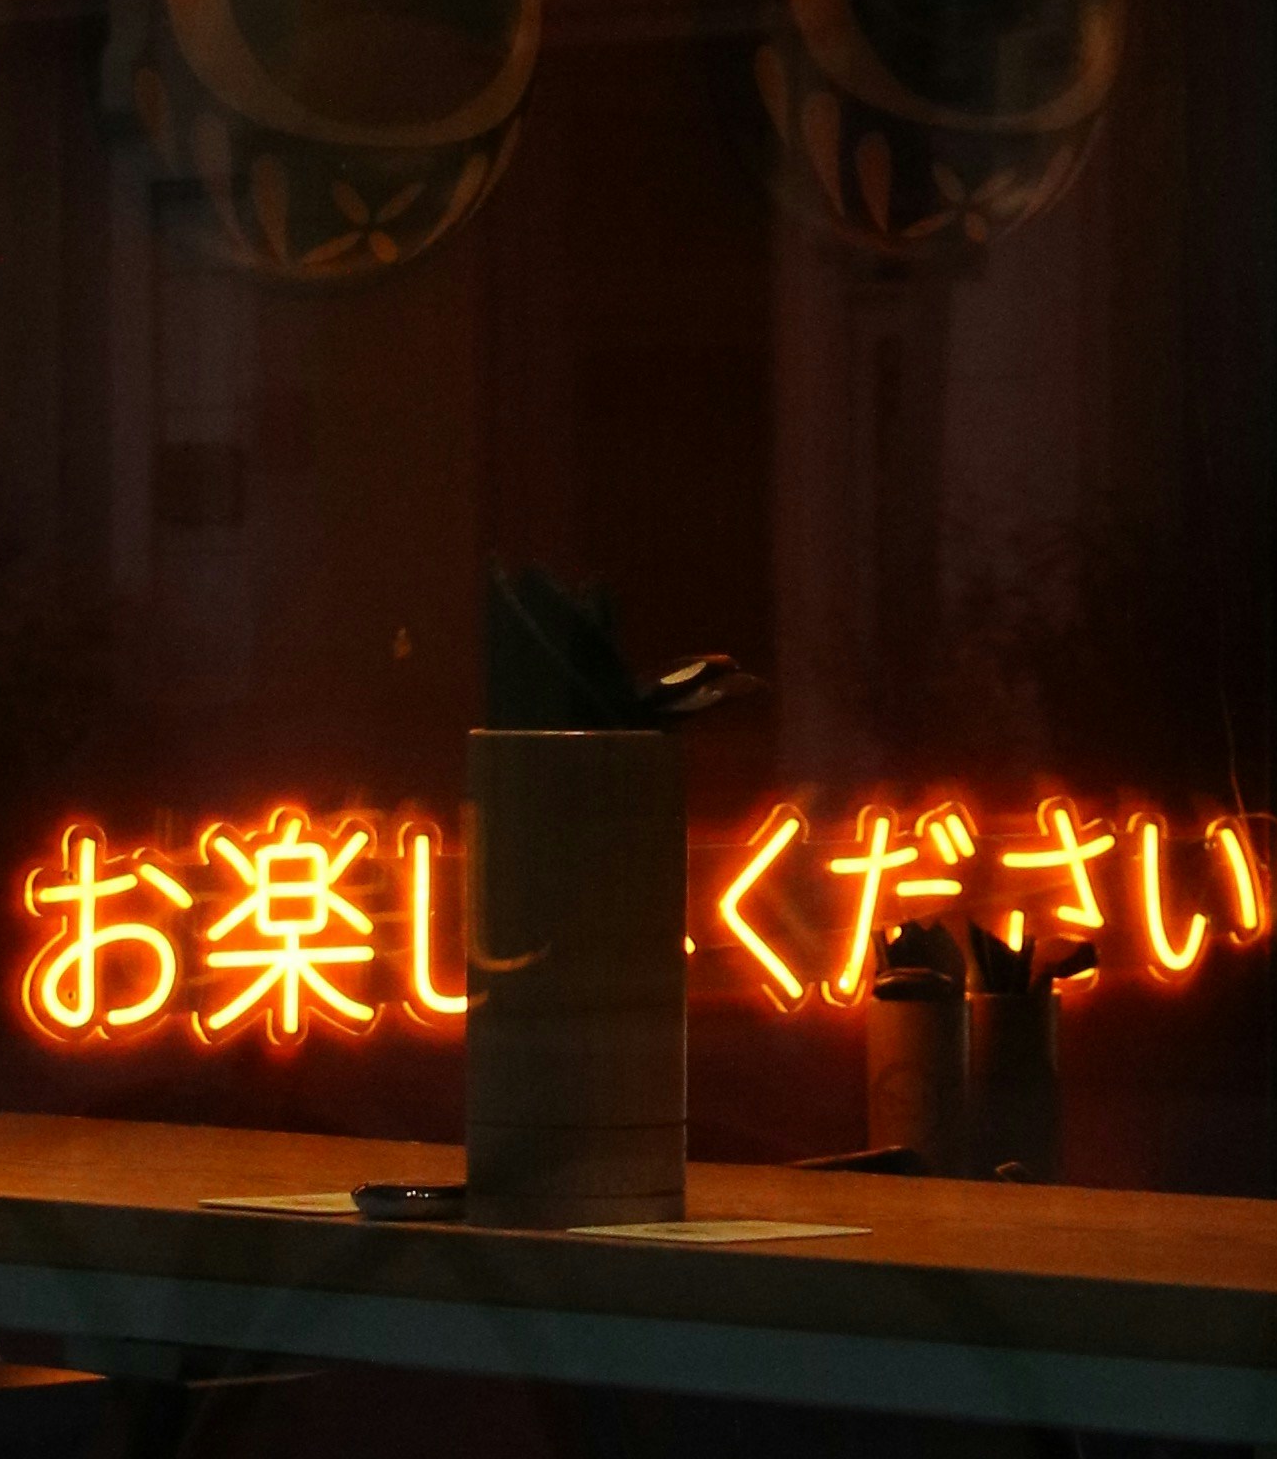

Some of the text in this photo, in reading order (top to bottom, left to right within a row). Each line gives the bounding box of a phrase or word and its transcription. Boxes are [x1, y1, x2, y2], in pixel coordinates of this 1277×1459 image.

[34, 806, 1261, 1036] お楽しください
